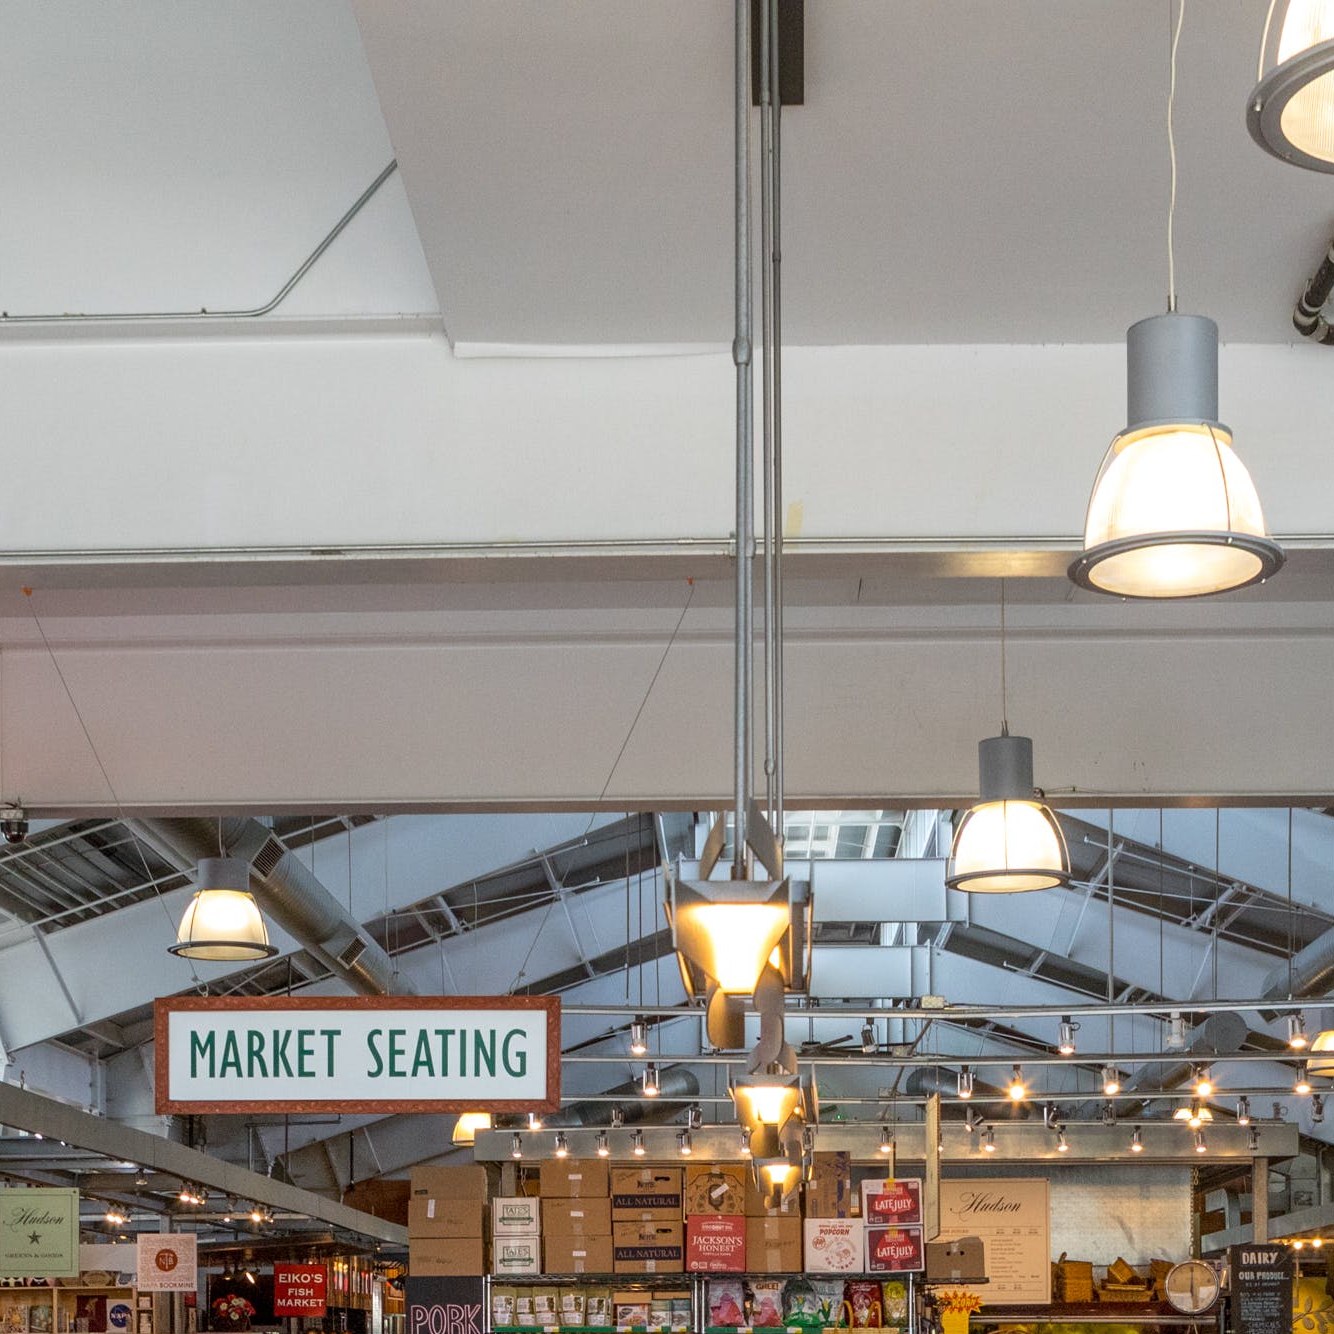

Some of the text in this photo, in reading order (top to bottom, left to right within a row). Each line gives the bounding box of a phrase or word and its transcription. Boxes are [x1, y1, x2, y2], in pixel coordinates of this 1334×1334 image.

[190, 1028, 528, 1079] MARKET SEATING
[616, 1196, 677, 1206] ALL NATURAL
[950, 1191, 1022, 1221] Hudson
[2, 1207, 65, 1232] Hudson
[819, 1228, 850, 1236] POPCORN
[692, 1235, 743, 1246] JACKSON'S
[699, 1244, 736, 1252] HONEST
[617, 1249, 679, 1258] ALL NATURAL
[1241, 1251, 1279, 1265] DAIRY
[278, 1273, 323, 1284] EIKO'S
[1238, 1271, 1255, 1281] OUR
[287, 1288, 314, 1297] FISH
[277, 1298, 324, 1308] MARKET
